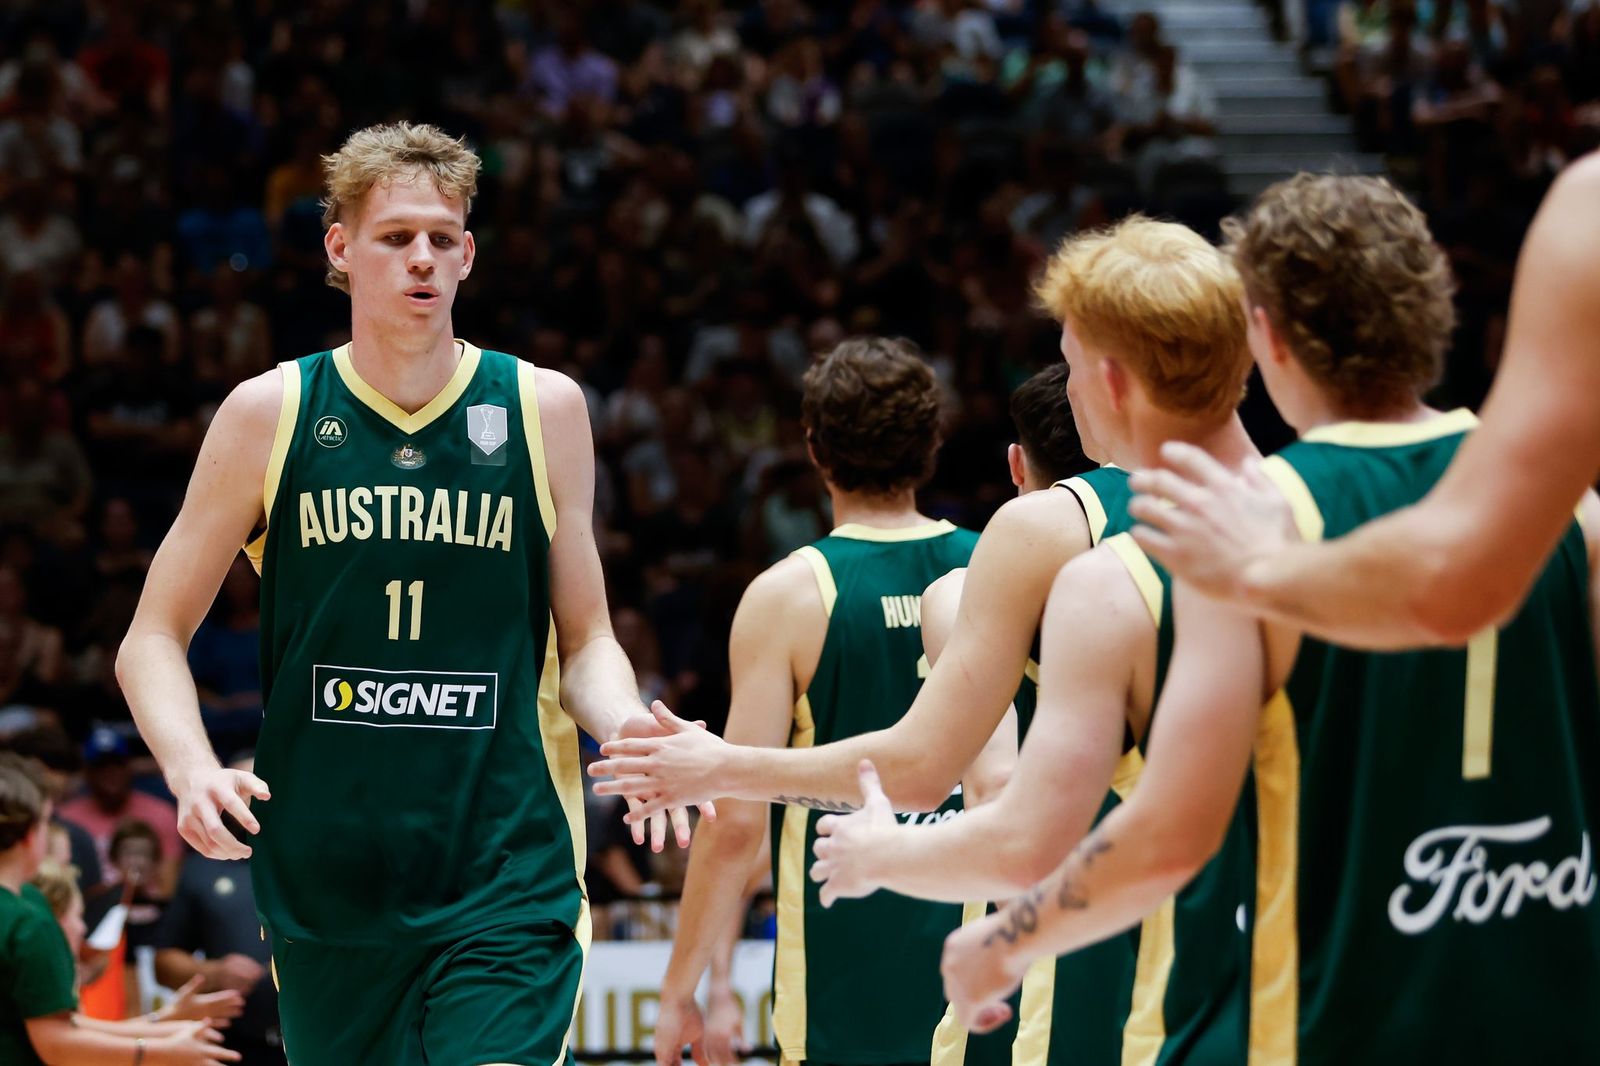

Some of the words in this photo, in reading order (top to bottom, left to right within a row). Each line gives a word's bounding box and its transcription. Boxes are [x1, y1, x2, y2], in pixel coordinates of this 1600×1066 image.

[299, 485, 513, 552] AUSTRALIA
[385, 579, 425, 641] 11
[354, 680, 487, 718] SIGNET
[1387, 815, 1597, 935] Ford
